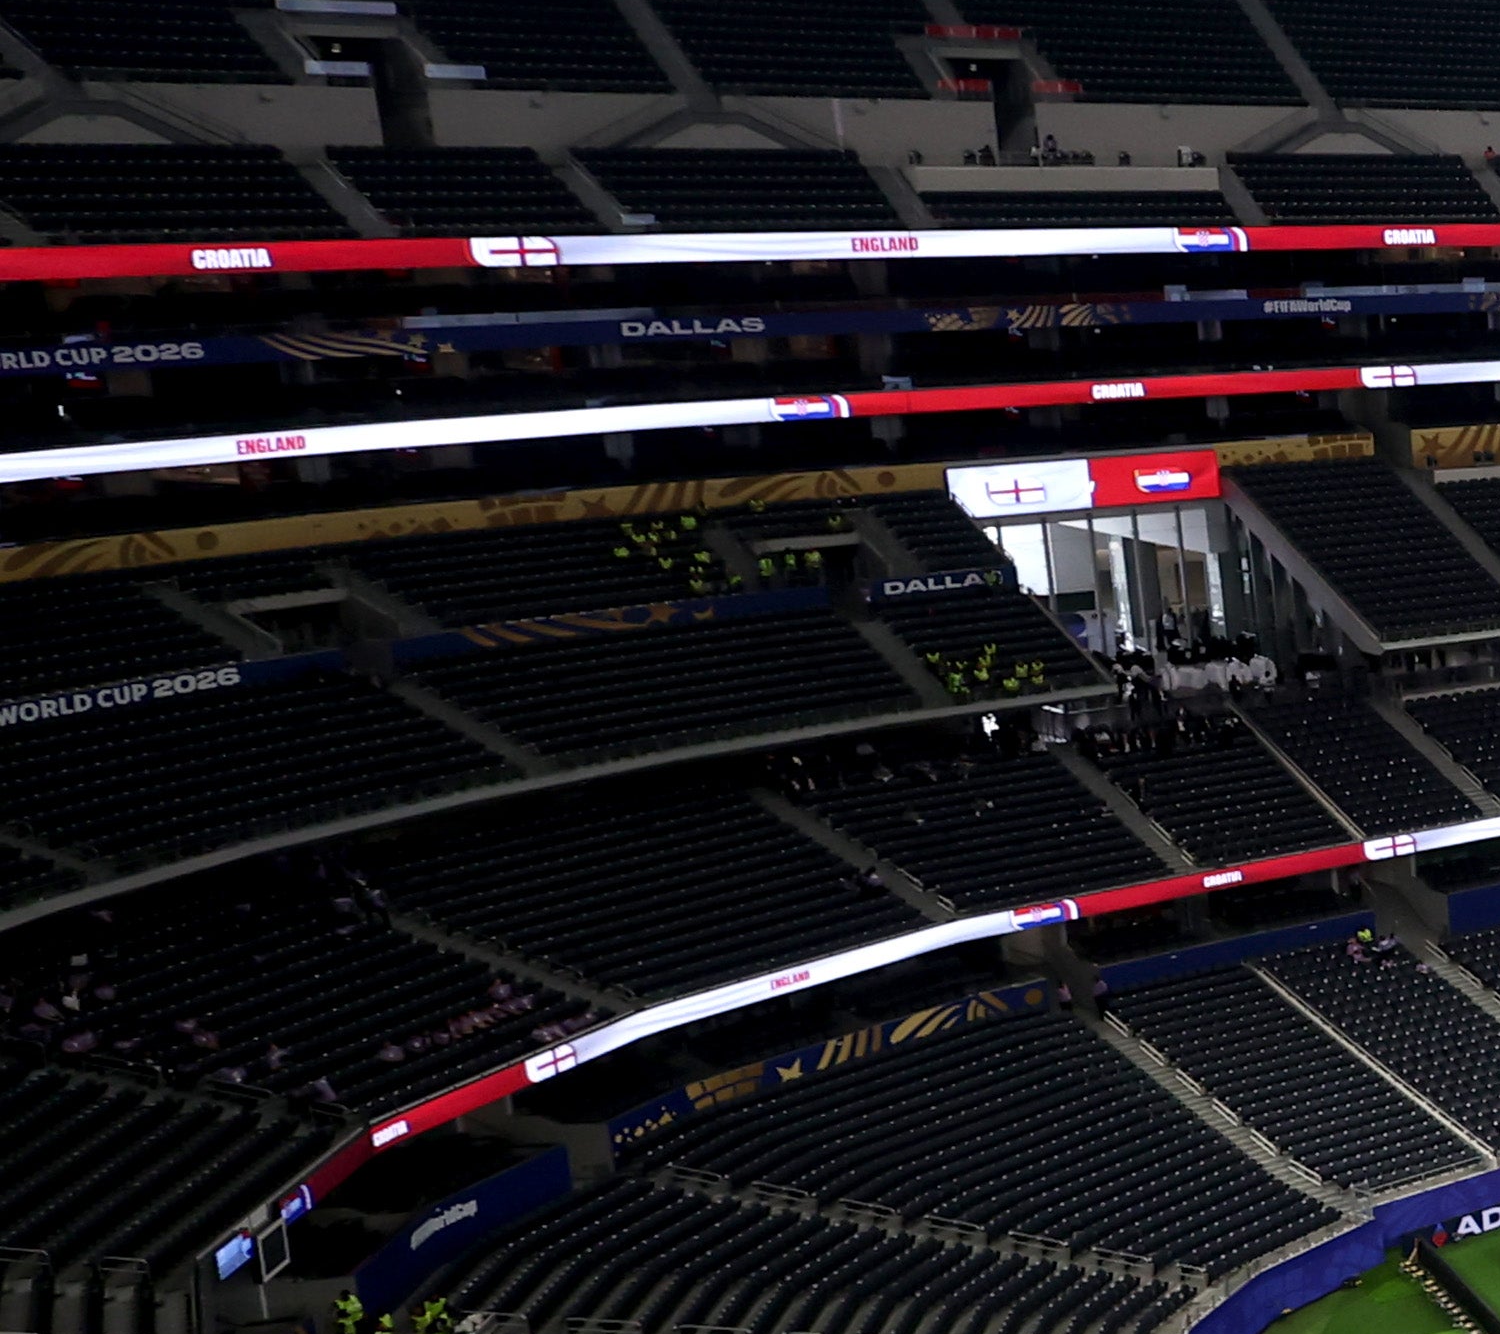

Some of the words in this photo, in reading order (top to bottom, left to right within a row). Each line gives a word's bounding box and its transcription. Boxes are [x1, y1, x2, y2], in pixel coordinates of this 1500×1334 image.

[851, 237, 919, 253] ENGLAND
[1383, 229, 1436, 246] CROATIA
[191, 247, 272, 270] CROATIA
[620, 317, 765, 336] DALLAS
[54, 348, 107, 366] CUP
[112, 342, 205, 363] 2026
[1092, 383, 1145, 398] CROATIA
[236, 436, 305, 455] ENGLAND
[97, 683, 147, 709] CUP
[152, 667, 241, 698] 2026
